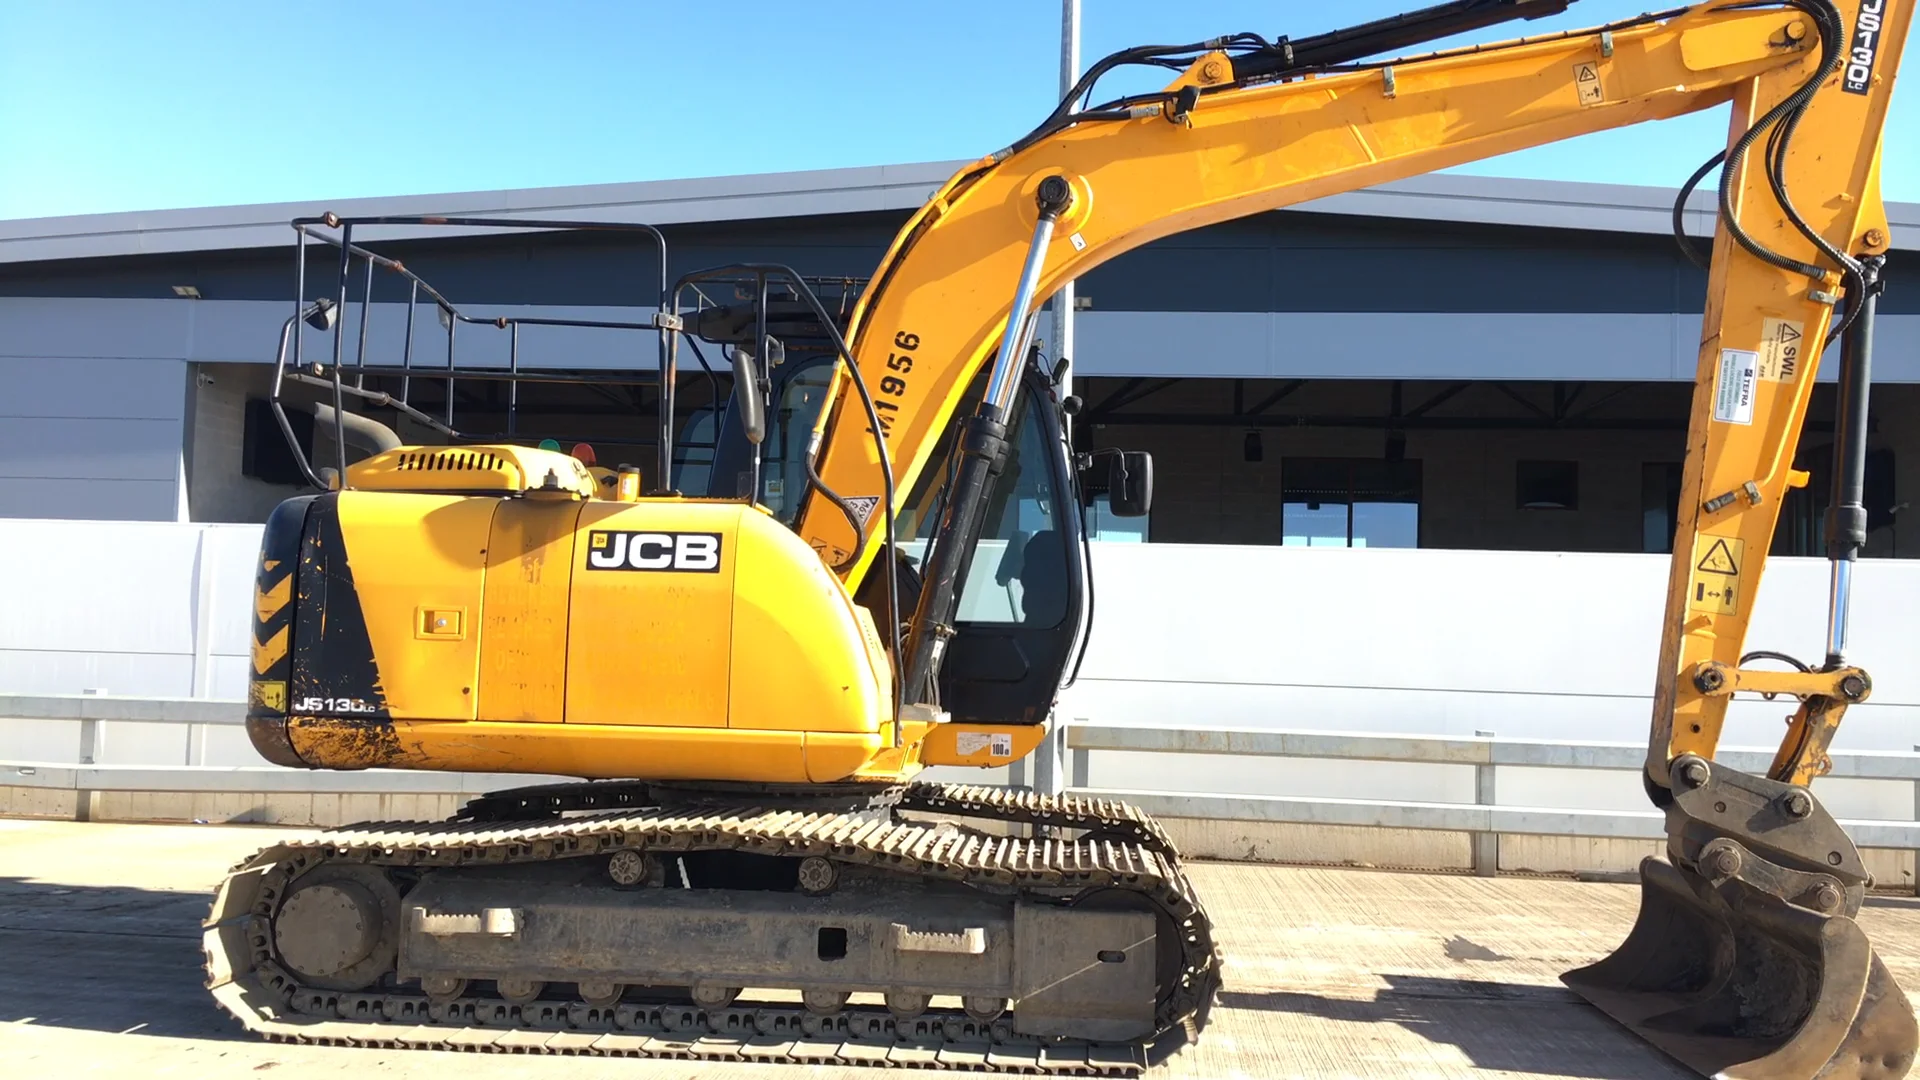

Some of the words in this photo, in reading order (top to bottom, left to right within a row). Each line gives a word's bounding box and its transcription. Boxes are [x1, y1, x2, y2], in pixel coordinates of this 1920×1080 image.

[1848, 0, 1883, 83] JS130
[1847, 81, 1863, 90] LC
[1780, 346, 1797, 380] SWL
[865, 330, 920, 438] M1956
[1741, 379, 1750, 406] TEFRA
[590, 533, 718, 569] JCB
